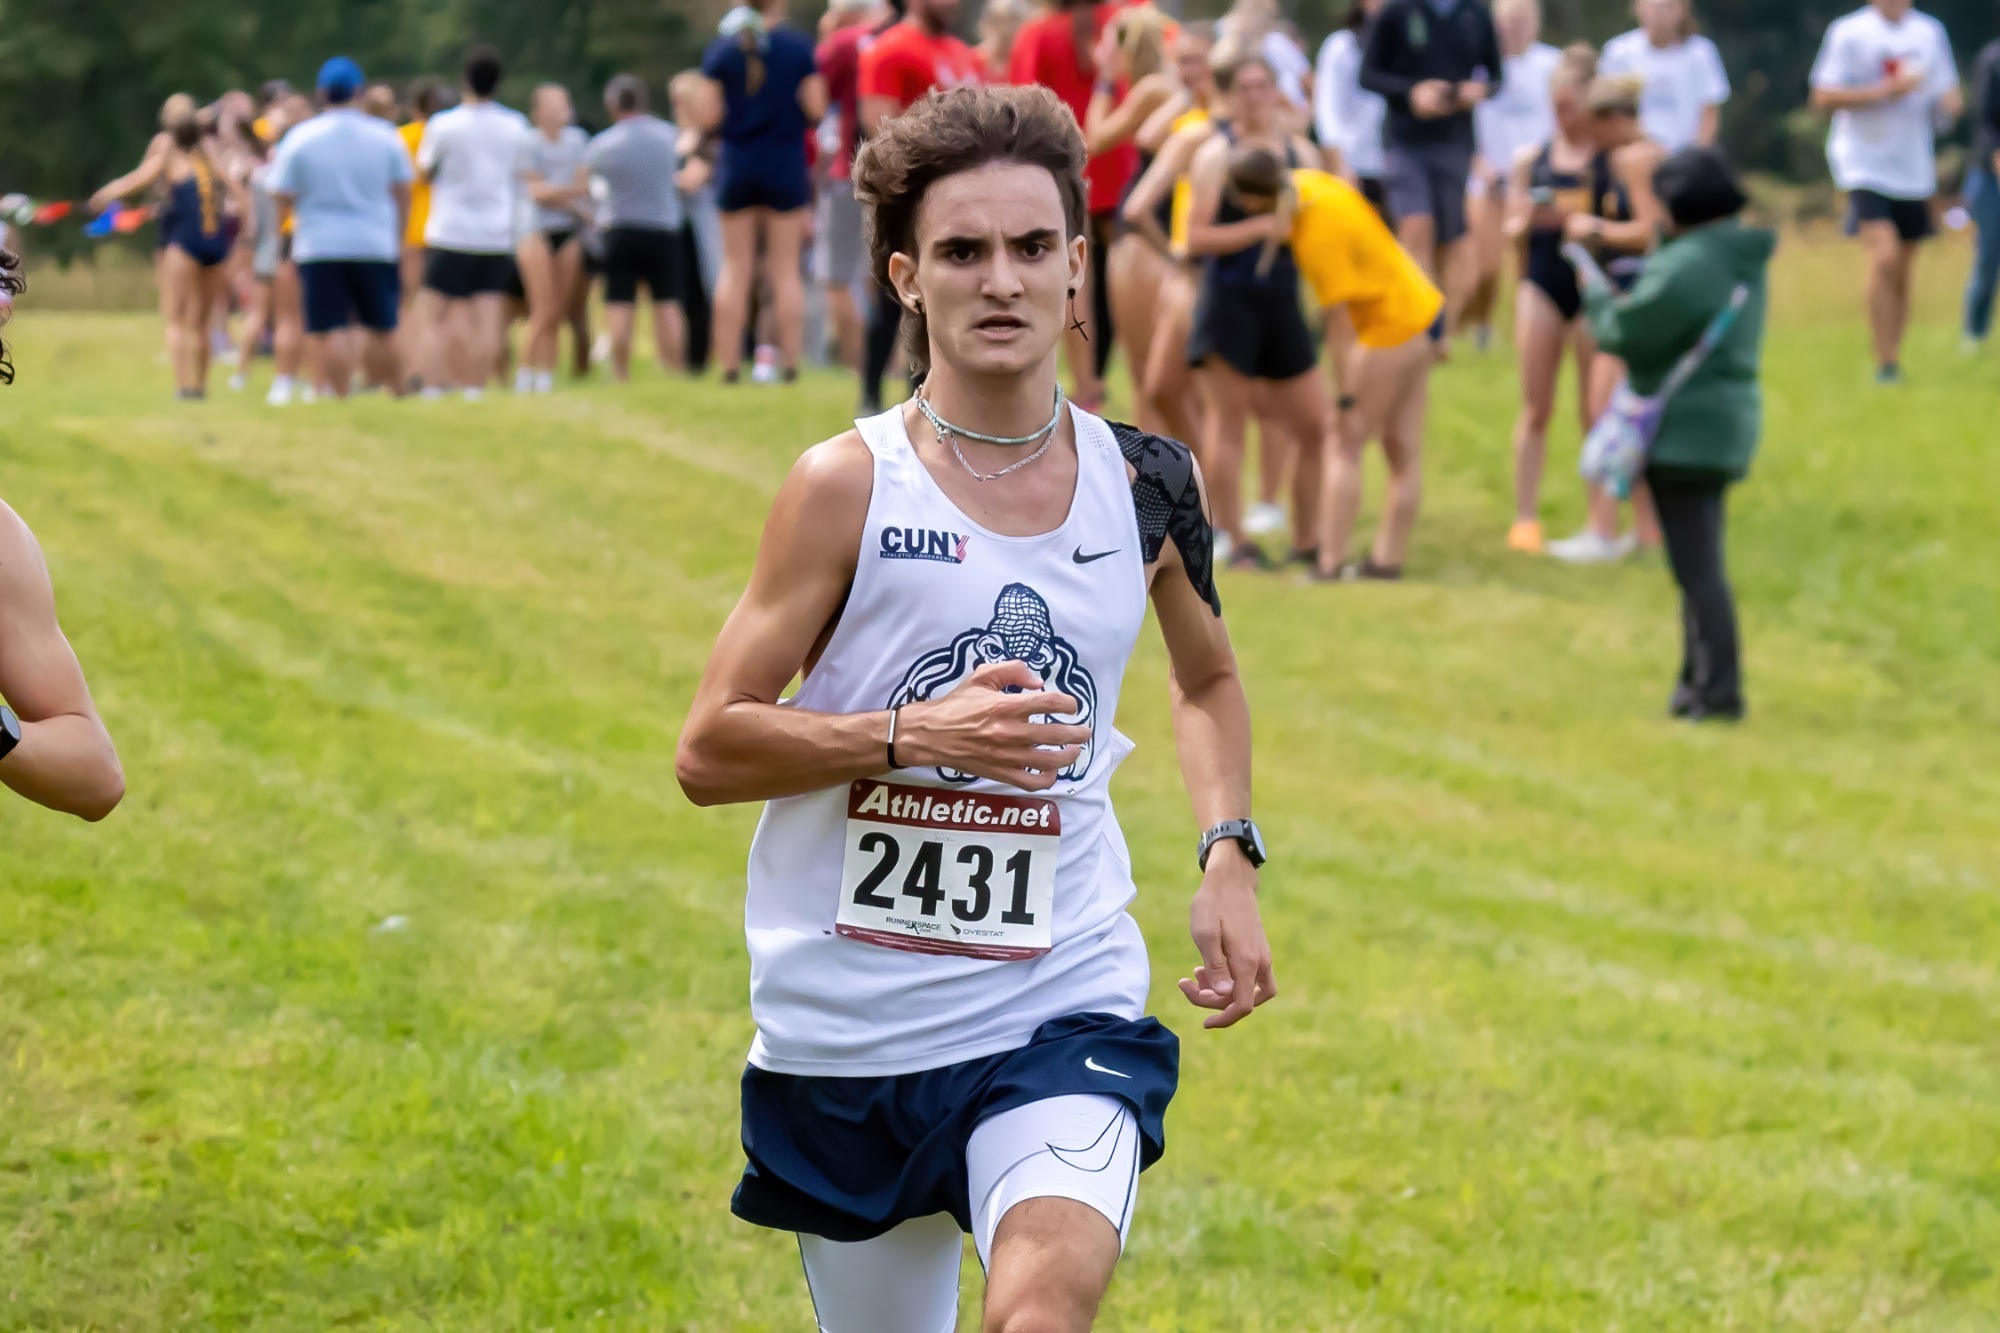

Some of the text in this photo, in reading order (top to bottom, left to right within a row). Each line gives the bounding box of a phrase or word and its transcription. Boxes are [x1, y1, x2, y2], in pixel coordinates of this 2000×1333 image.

[880, 526, 970, 558] CUNY
[856, 785, 1050, 827] Athletic.net
[853, 832, 1034, 926] 2431
